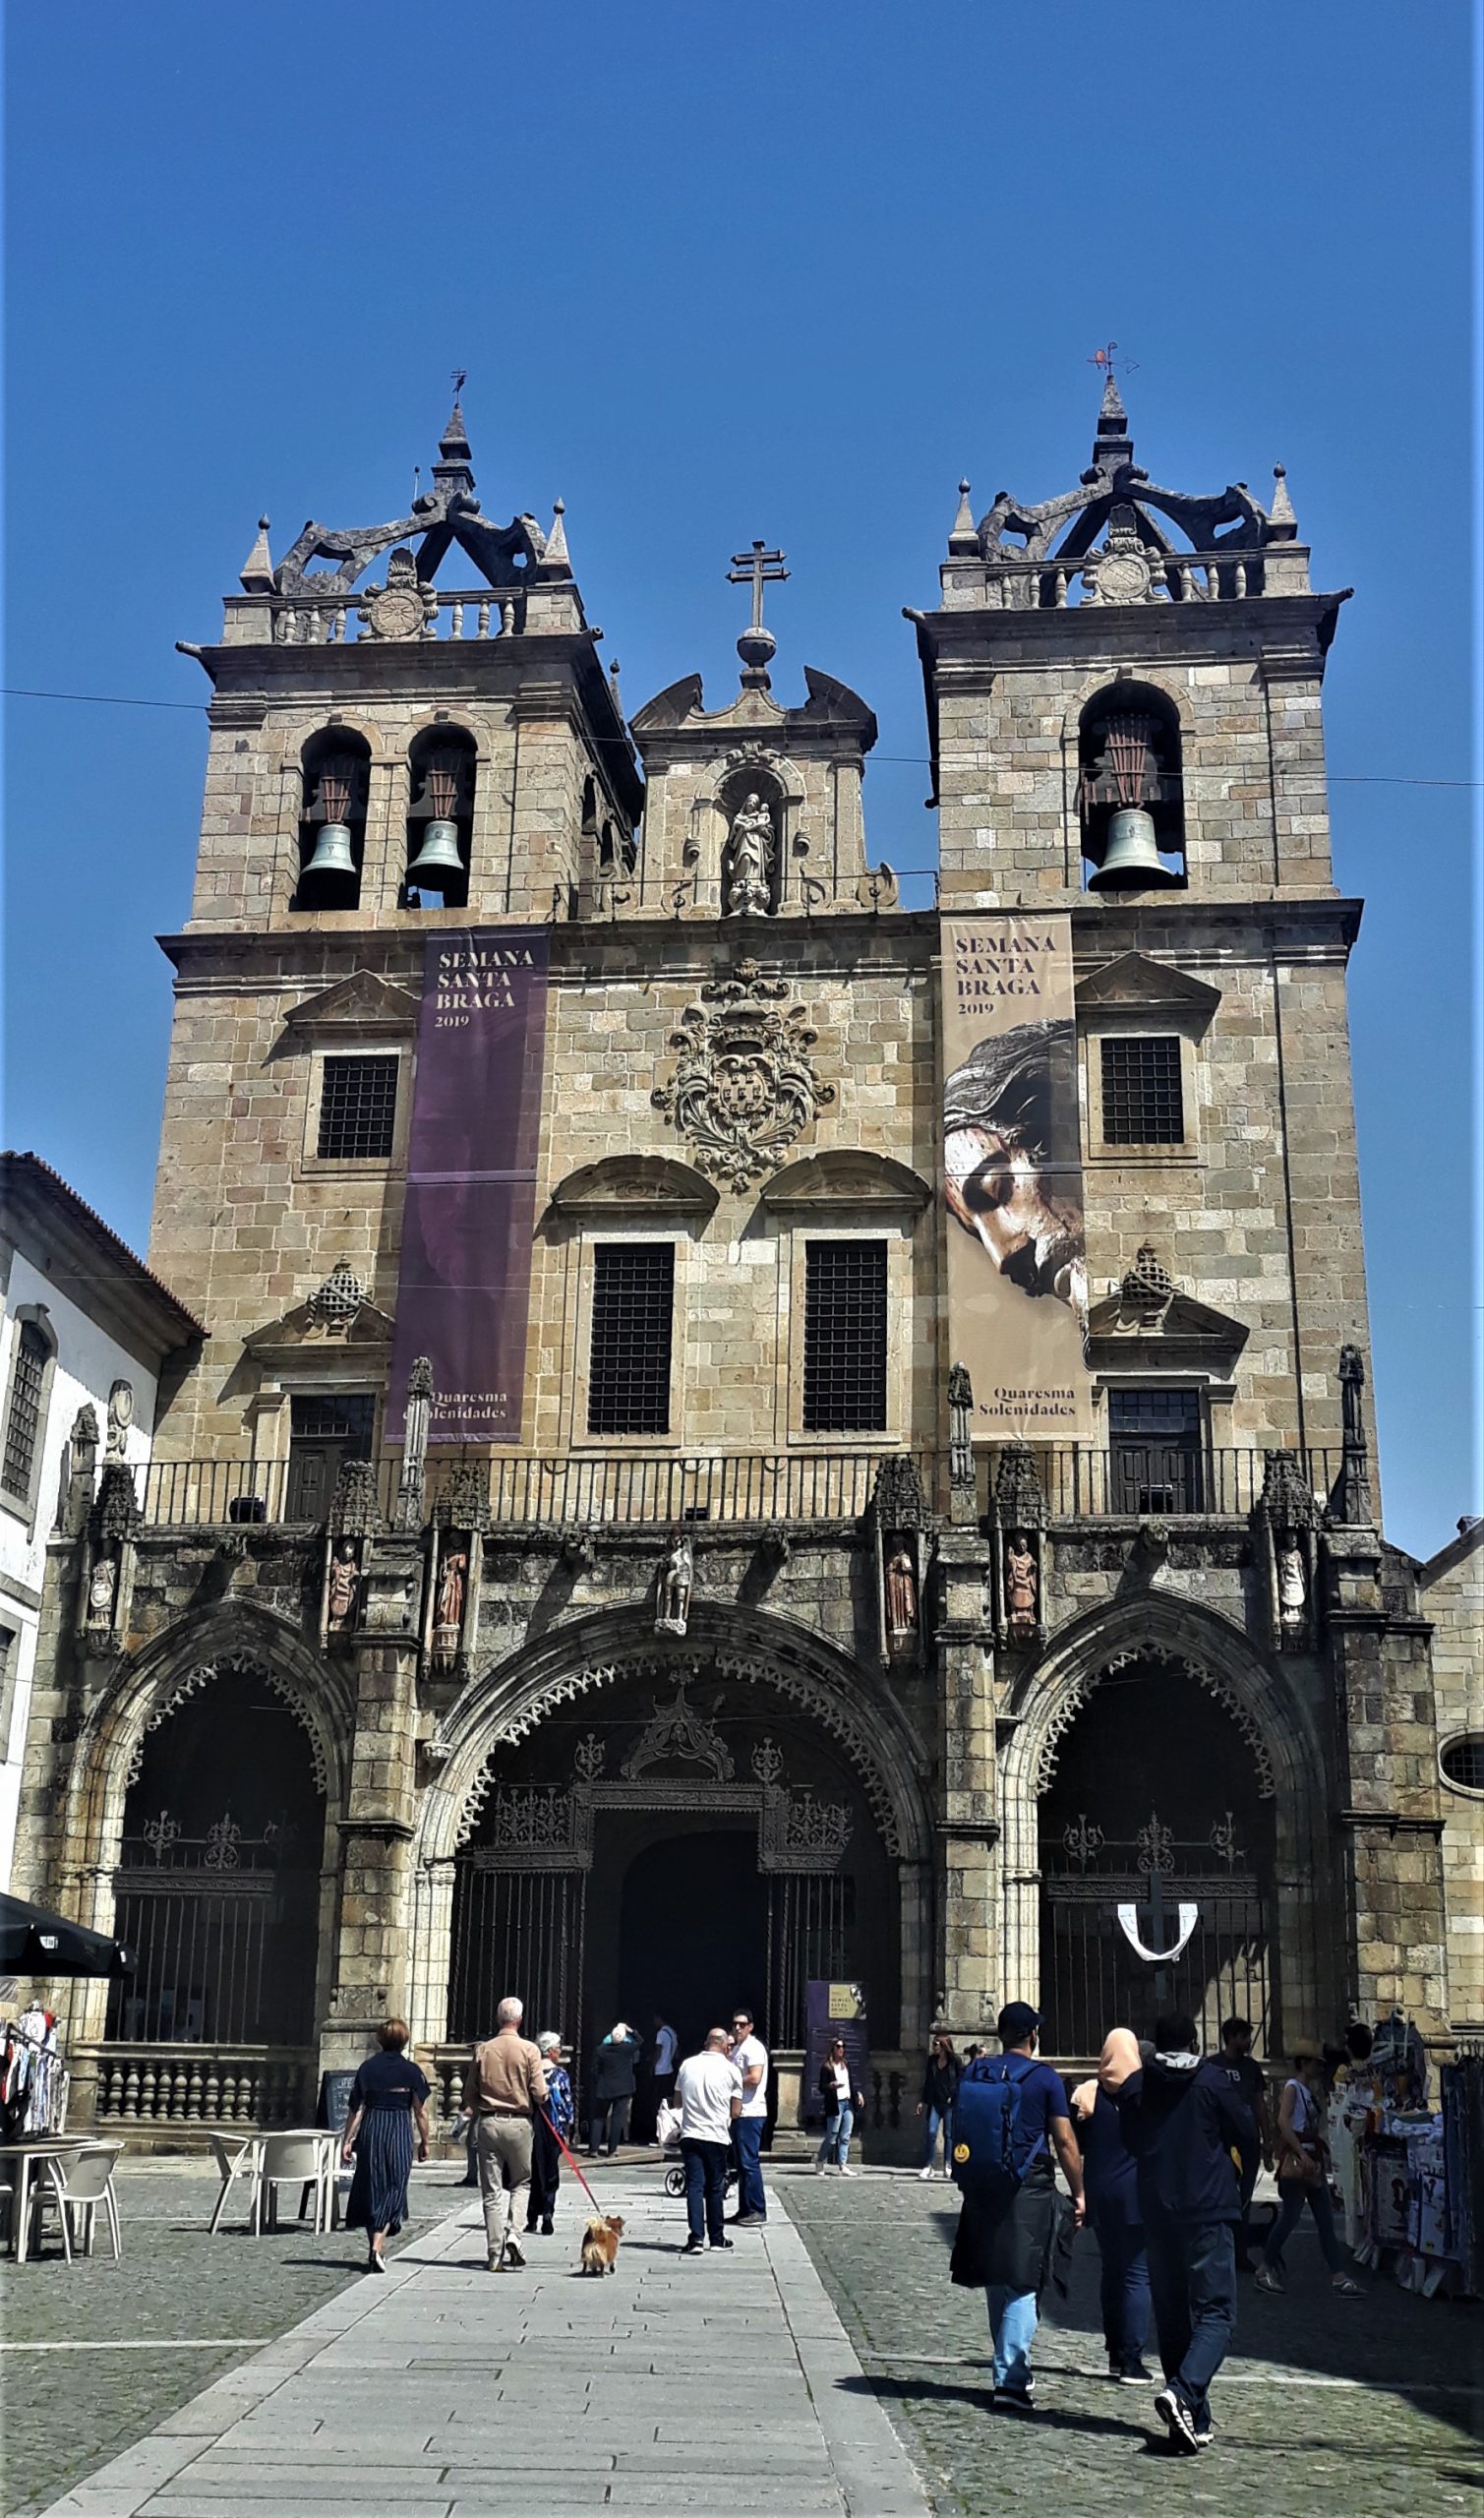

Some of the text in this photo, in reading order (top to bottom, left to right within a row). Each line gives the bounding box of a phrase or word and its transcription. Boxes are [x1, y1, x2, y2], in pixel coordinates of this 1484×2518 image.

[956, 935, 1056, 953] SEMANA
[439, 949, 534, 969] SEMANA
[956, 957, 1035, 975] SANTA
[438, 971, 511, 989] SANTA
[957, 979, 1040, 996] BRAGA
[436, 991, 515, 1009] BRAGA
[958, 1003, 994, 1015] 2019
[435, 1015, 470, 1028] 2019
[432, 1391, 507, 1407] Quaresma
[994, 1387, 1075, 1403] Quaresma
[429, 1406, 506, 1419] lenidades
[979, 1403, 1076, 1416] Solenidades
